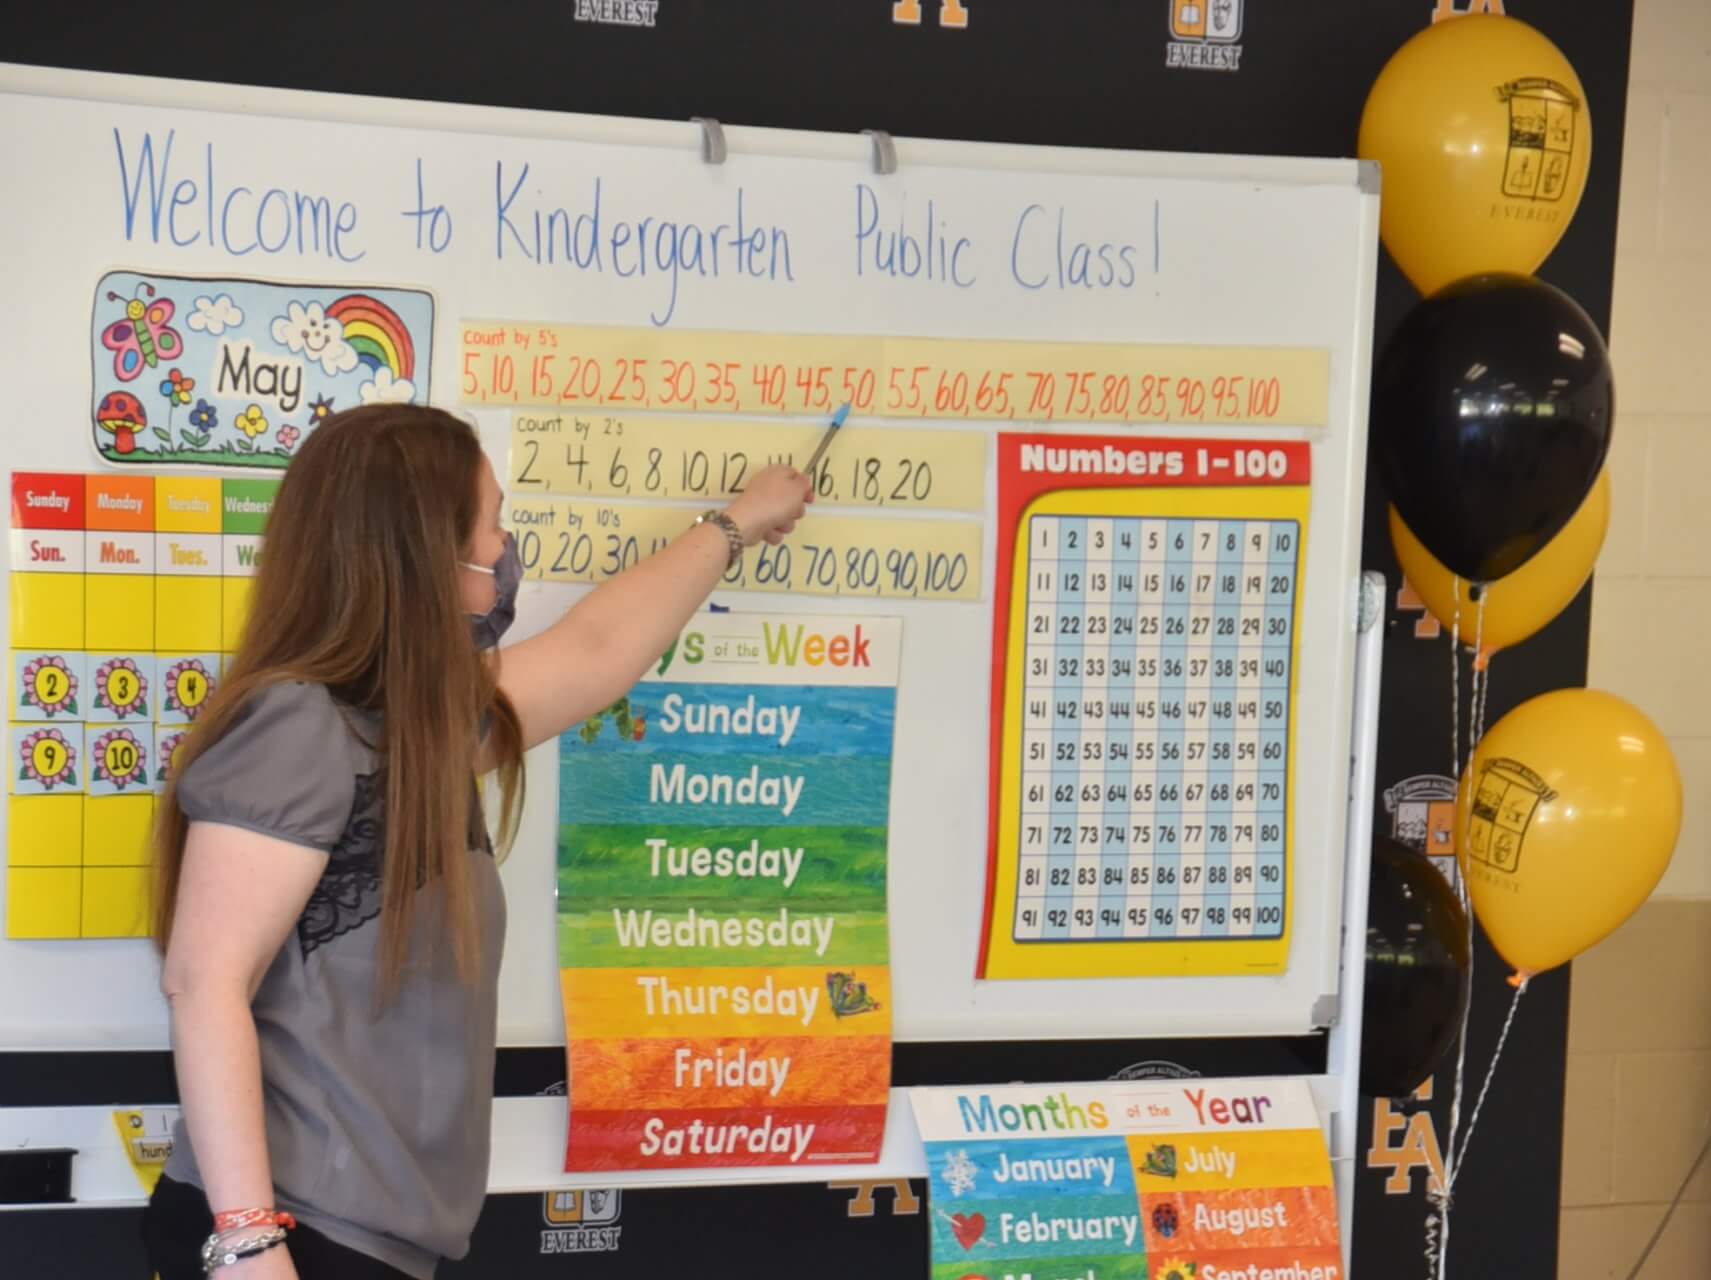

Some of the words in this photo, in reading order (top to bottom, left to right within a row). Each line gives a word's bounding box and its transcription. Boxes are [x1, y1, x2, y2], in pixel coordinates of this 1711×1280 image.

[575, 0, 659, 27] EVEREST
[1166, 41, 1243, 70] EVEREST
[113, 127, 366, 262] Welcome
[402, 158, 453, 253] to
[495, 160, 795, 327] Kindergarten
[855, 183, 976, 287] Public
[1011, 200, 1160, 297] Class!
[463, 329, 506, 347] count
[514, 329, 531, 350] by
[538, 329, 559, 348] 5's
[217, 344, 302, 412] May
[1249, 376, 1281, 418] 100
[516, 416, 563, 434] count
[575, 417, 590, 440] by
[603, 417, 624, 436] 2's
[1020, 444, 1184, 477] Numbers
[25, 488, 70, 513] Sunday
[97, 491, 143, 515] Monday
[223, 495, 274, 514] Wednes
[512, 509, 556, 524] count
[568, 507, 584, 529] by
[30, 540, 66, 564] Sun.
[99, 541, 141, 565] Mon.
[169, 542, 209, 567] Tues.
[236, 544, 265, 567] We
[1042, 529, 1048, 548] 1
[1068, 530, 1077, 549] 2
[1095, 530, 1105, 549] 3
[1121, 533, 1131, 549] 4
[1148, 531, 1158, 551] 5
[1174, 533, 1185, 551] 6
[1201, 532, 1211, 551] 7
[1226, 533, 1236, 552] 8
[1251, 533, 1262, 552] 9
[1275, 533, 1291, 553] 10
[713, 641, 728, 657] of
[737, 641, 760, 658] the
[763, 622, 870, 667] Week
[1032, 657, 1048, 677] 31
[1059, 658, 1079, 677] 32
[1085, 658, 1105, 677] 33
[1111, 659, 1131, 677] 34
[1138, 658, 1157, 677] 35
[1163, 658, 1182, 677] 36
[1189, 659, 1208, 677] 37
[1215, 659, 1233, 678] 38
[1240, 659, 1258, 678] 39
[1265, 659, 1285, 678] 40
[45, 673, 58, 697] 2
[117, 676, 129, 700] 3
[187, 676, 197, 700] 4
[659, 693, 801, 747] Sunday
[43, 745, 56, 770] 9
[111, 745, 134, 770] 10
[650, 763, 805, 816] Monday
[1028, 785, 1044, 803] 61
[1054, 784, 1074, 803] 62
[1081, 783, 1101, 802] 63
[1107, 785, 1127, 803] 64
[1133, 783, 1153, 802] 65
[1159, 784, 1179, 802] 66
[1185, 783, 1204, 801] 67
[1210, 783, 1229, 801] 68
[1235, 783, 1254, 801] 69
[1262, 782, 1280, 801] 70
[645, 839, 805, 888] Tuesday
[613, 908, 834, 957] Wednesday
[1022, 909, 1037, 927] 91
[1047, 909, 1067, 928] 92
[1074, 909, 1094, 927] 93
[1100, 909, 1121, 926] 94
[1127, 908, 1147, 926] 95
[1154, 907, 1174, 926] 96
[1180, 907, 1201, 925] 97
[1206, 907, 1225, 925] 98
[1232, 907, 1252, 924] 99
[1256, 906, 1281, 924] 100
[637, 976, 820, 1027] Thursday
[674, 1047, 791, 1097] Friday
[958, 1091, 1110, 1133] Months
[1126, 1104, 1142, 1118] of
[1146, 1103, 1172, 1118] the
[1183, 1088, 1272, 1126] Year
[139, 1139, 173, 1161] hund
[640, 1116, 815, 1162] Saturday
[992, 1153, 1115, 1187] January
[1183, 1146, 1236, 1178] July
[1000, 1211, 1138, 1246] February
[1193, 1201, 1287, 1236] August
[540, 1226, 622, 1254] EVEREST
